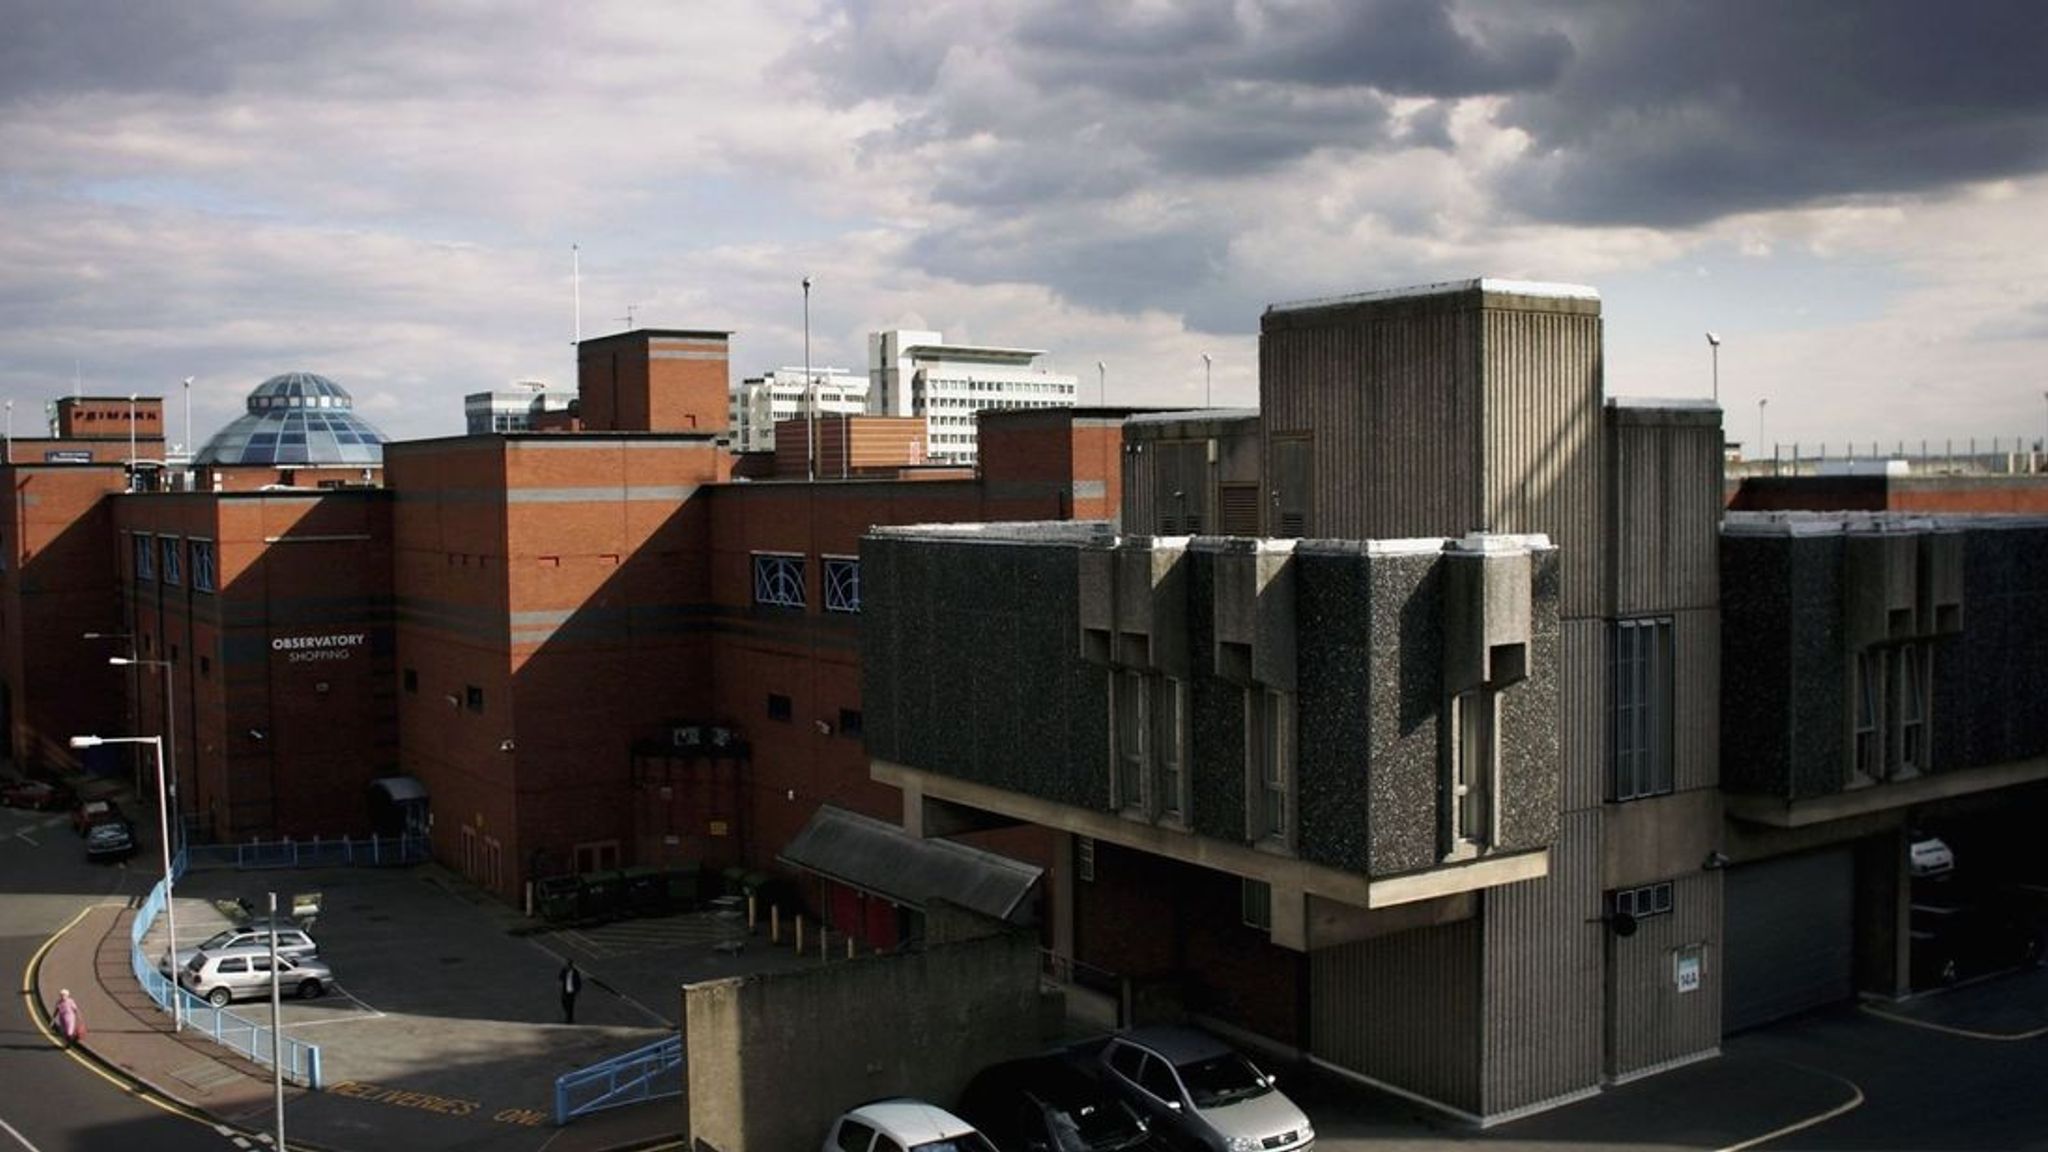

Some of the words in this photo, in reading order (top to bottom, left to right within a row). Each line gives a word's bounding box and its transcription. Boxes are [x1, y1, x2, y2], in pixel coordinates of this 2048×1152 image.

[74, 411, 157, 421] PRIMARK
[272, 635, 364, 649] OBSERVATORY
[289, 650, 349, 661] SHOPPING
